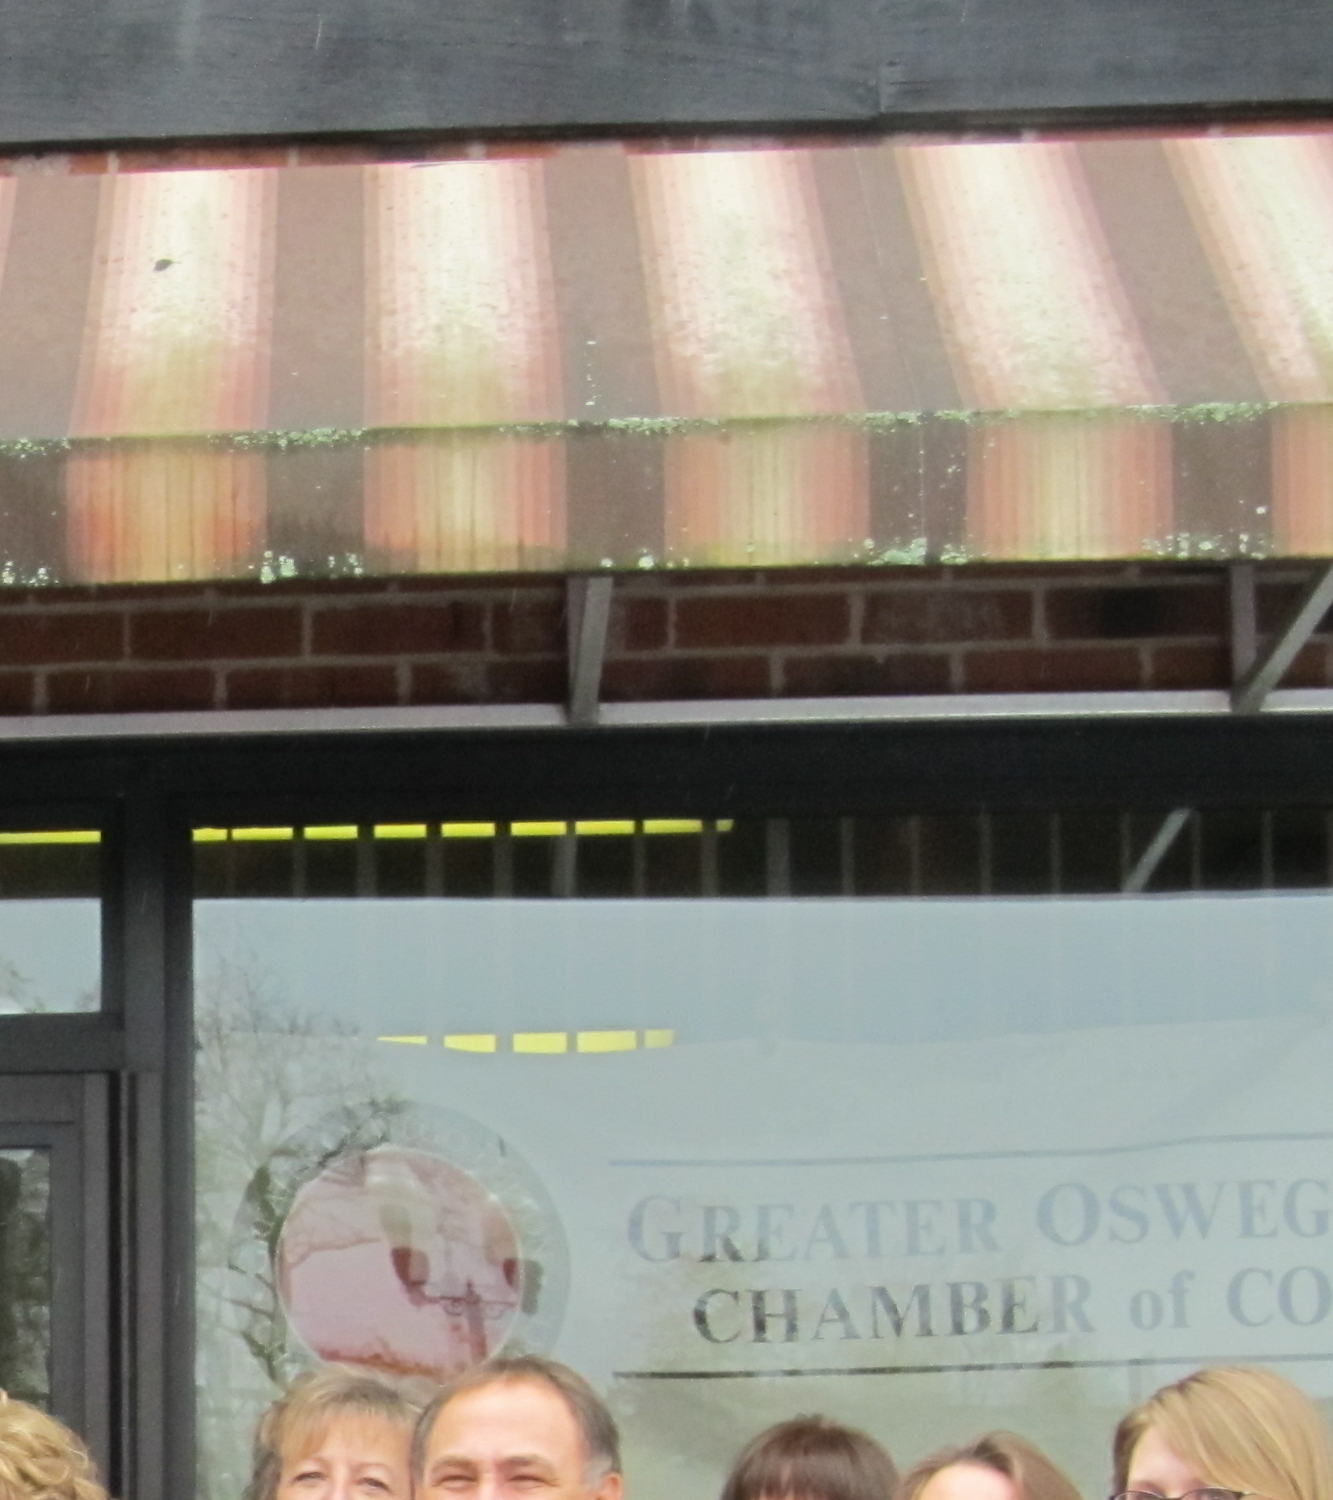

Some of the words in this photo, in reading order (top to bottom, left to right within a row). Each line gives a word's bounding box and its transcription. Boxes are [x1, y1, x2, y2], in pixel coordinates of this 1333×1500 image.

[627, 1193, 999, 1262] GREATER
[692, 1272, 1096, 1344] CHAMBER
[1129, 1270, 1195, 1330] of
[1226, 1266, 1333, 1328] CO
